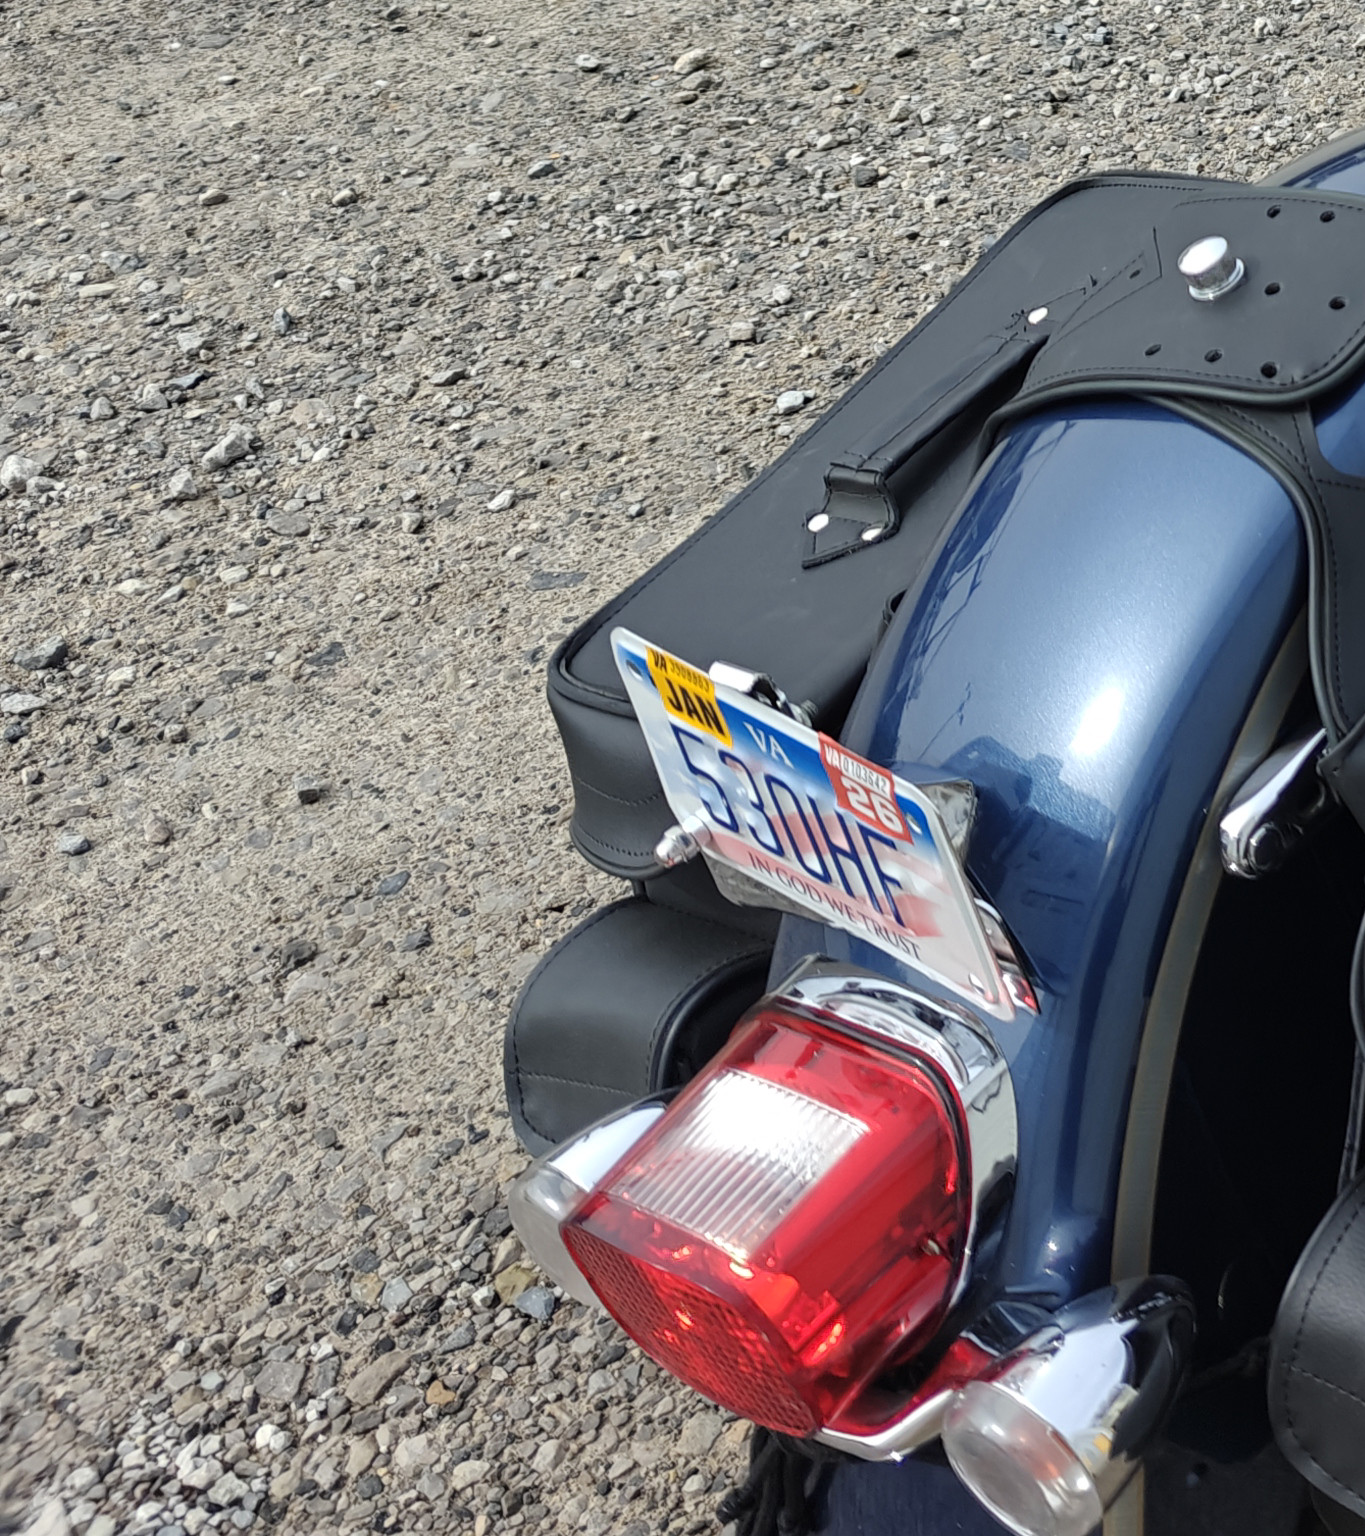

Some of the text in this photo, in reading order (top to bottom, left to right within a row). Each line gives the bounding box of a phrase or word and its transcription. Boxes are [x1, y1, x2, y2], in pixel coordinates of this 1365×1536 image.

[651, 650, 667, 673] VA
[665, 677, 726, 737] JAN
[743, 722, 794, 769] VA
[824, 744, 841, 770] VA
[840, 775, 904, 834] 26
[749, 852, 922, 961] IN GOD WE TRUST
